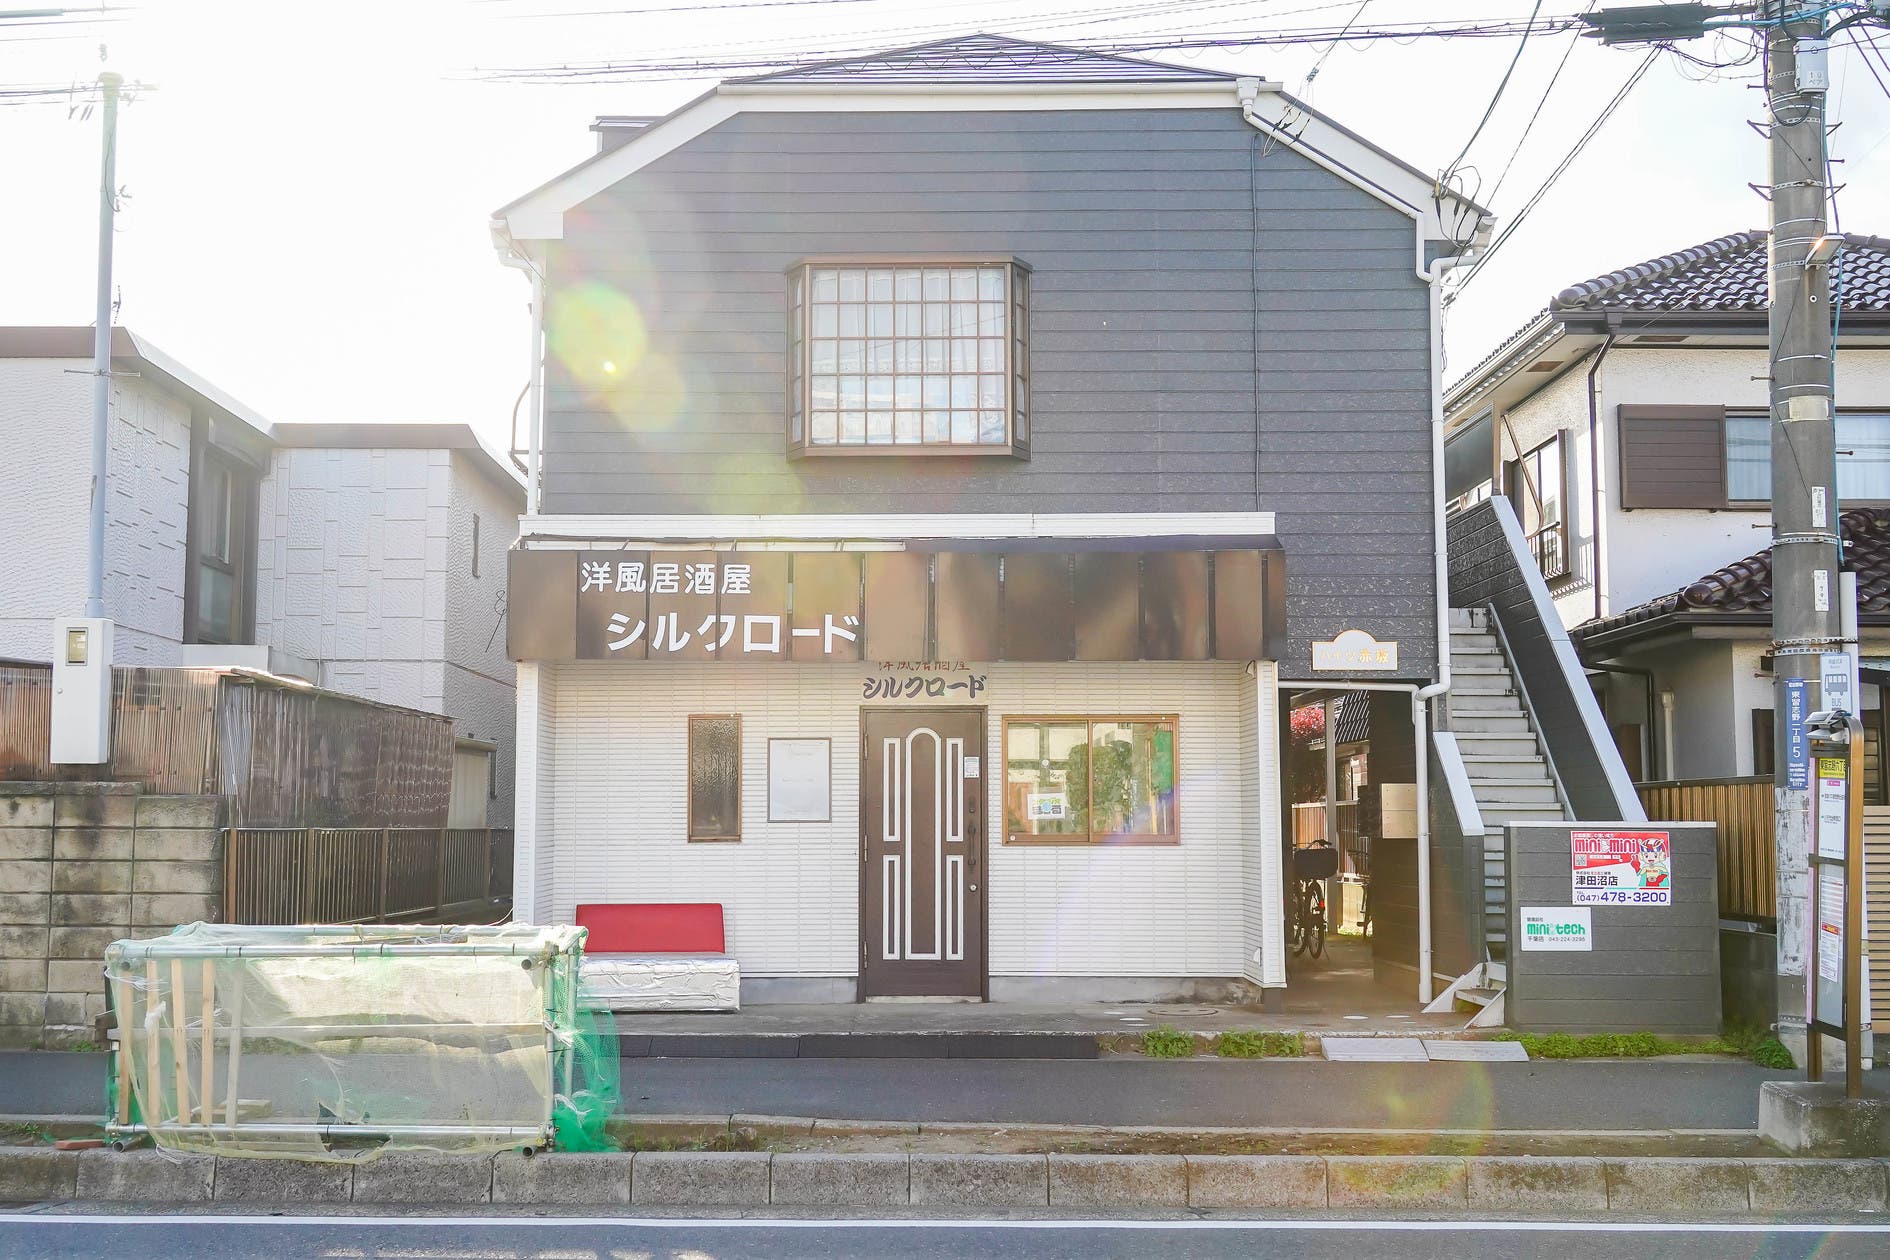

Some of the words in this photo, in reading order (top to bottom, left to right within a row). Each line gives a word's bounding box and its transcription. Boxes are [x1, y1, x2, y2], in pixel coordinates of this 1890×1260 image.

[581, 561, 752, 595] 洋風居酒屋
[606, 612, 860, 654] シルクロード
[862, 674, 987, 699] シルクロード
[1574, 838, 1601, 853] mini
[1609, 838, 1637, 853] mini
[1575, 875, 1618, 886] 津田沼店
[1527, 923, 1550, 935] mini
[1555, 923, 1586, 935] tech
